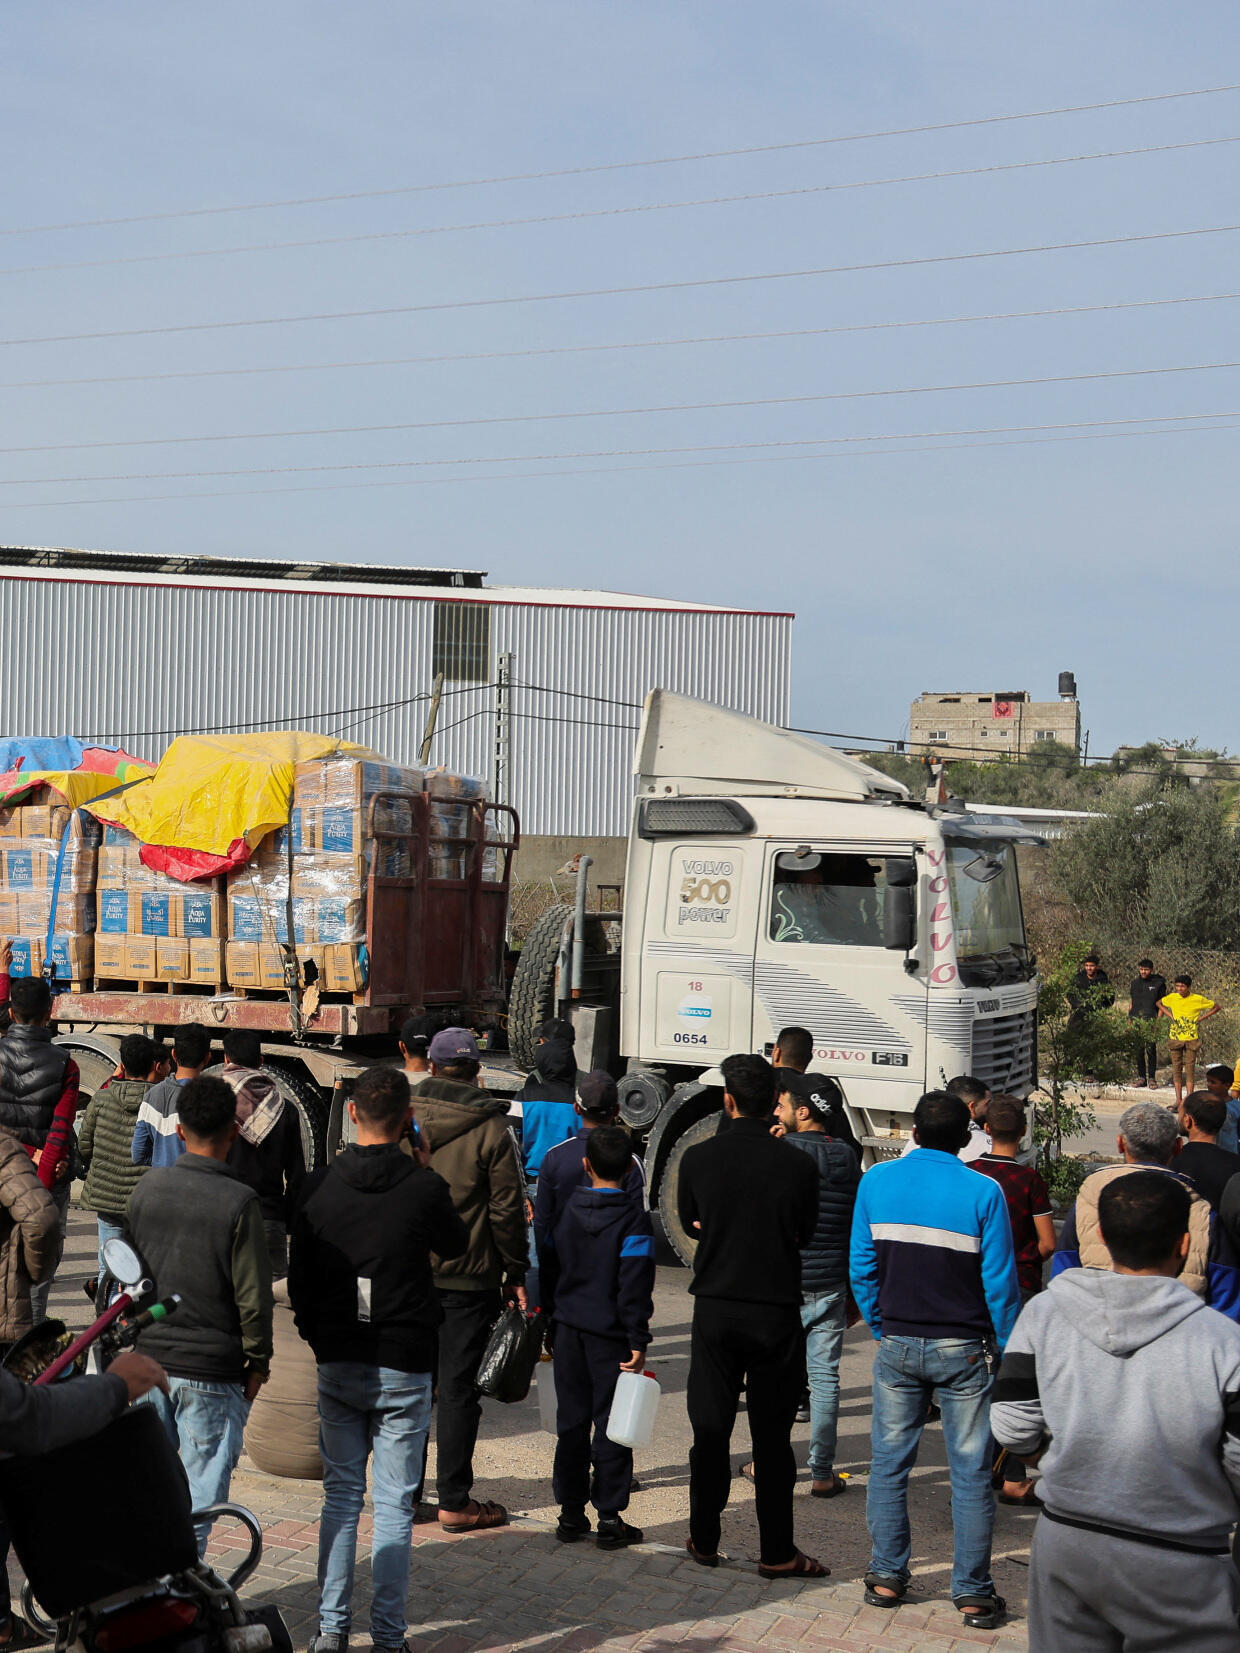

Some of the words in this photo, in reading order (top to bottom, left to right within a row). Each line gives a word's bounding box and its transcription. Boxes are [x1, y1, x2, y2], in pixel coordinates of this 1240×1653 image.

[682, 860, 734, 876] VOLVO
[680, 877, 731, 905] 500
[678, 907, 731, 925] power
[927, 849, 957, 984] VOLVO
[688, 981, 703, 992] 18
[673, 1032, 707, 1045] 0654
[875, 1052, 904, 1066] F16
